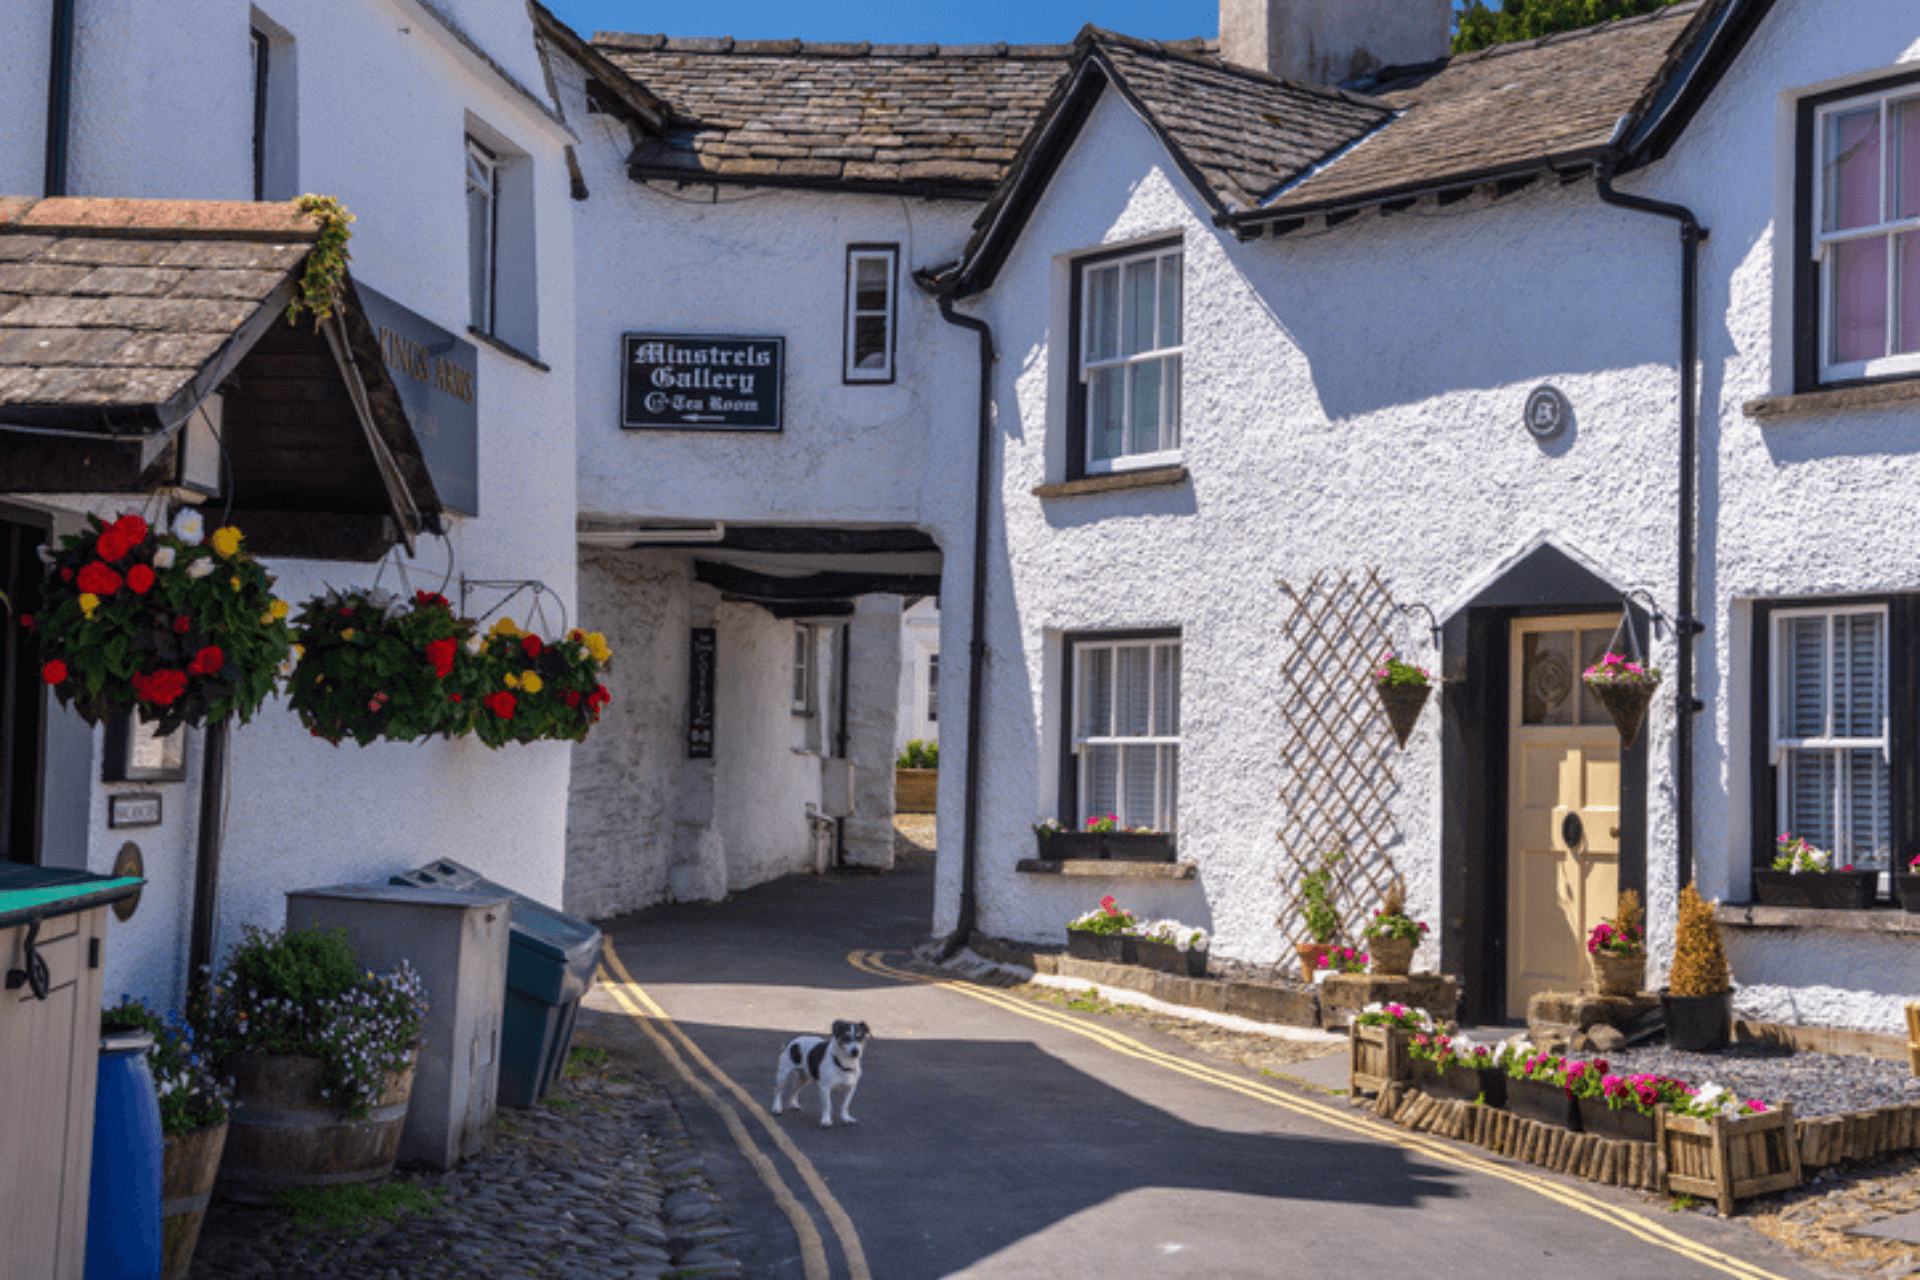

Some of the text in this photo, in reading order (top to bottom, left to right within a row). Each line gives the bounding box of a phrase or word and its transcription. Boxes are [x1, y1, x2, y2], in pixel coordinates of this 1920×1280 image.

[379, 326, 474, 405] KINGS ARMS
[633, 342, 771, 366] Minstrels
[651, 366, 755, 394] Gallery
[671, 394, 703, 411] Tea
[709, 395, 760, 412] Room
